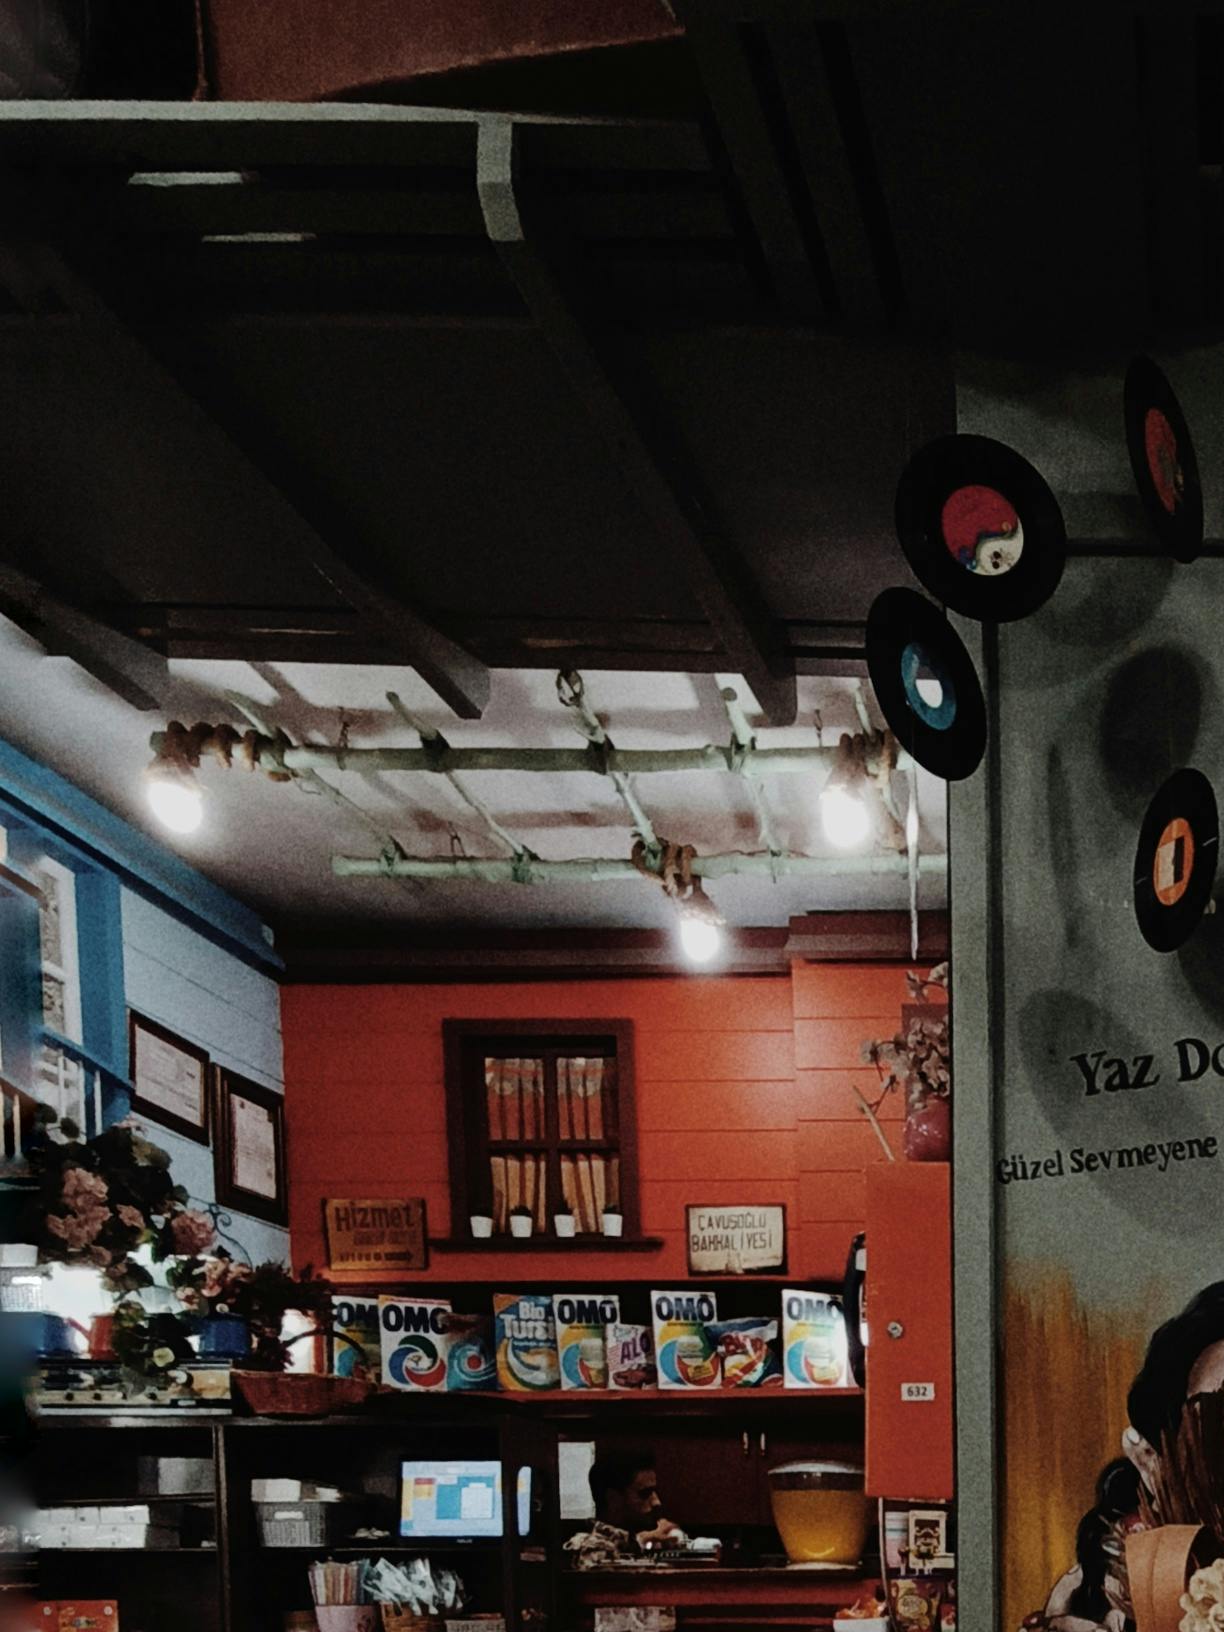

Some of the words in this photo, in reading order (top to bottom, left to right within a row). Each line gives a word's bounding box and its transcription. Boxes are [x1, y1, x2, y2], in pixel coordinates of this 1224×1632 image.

[1070, 1050, 1161, 1097] Yaz
[997, 1149, 1064, 1185] Güzel
[1069, 1134, 1218, 1175] Sevmeyene
[336, 1302, 379, 1327] OM
[557, 1299, 618, 1324] OMO
[655, 1296, 714, 1322] OMO
[786, 1297, 843, 1321] OMO
[498, 1313, 556, 1340] Tursi
[907, 1386, 928, 1397] 632
